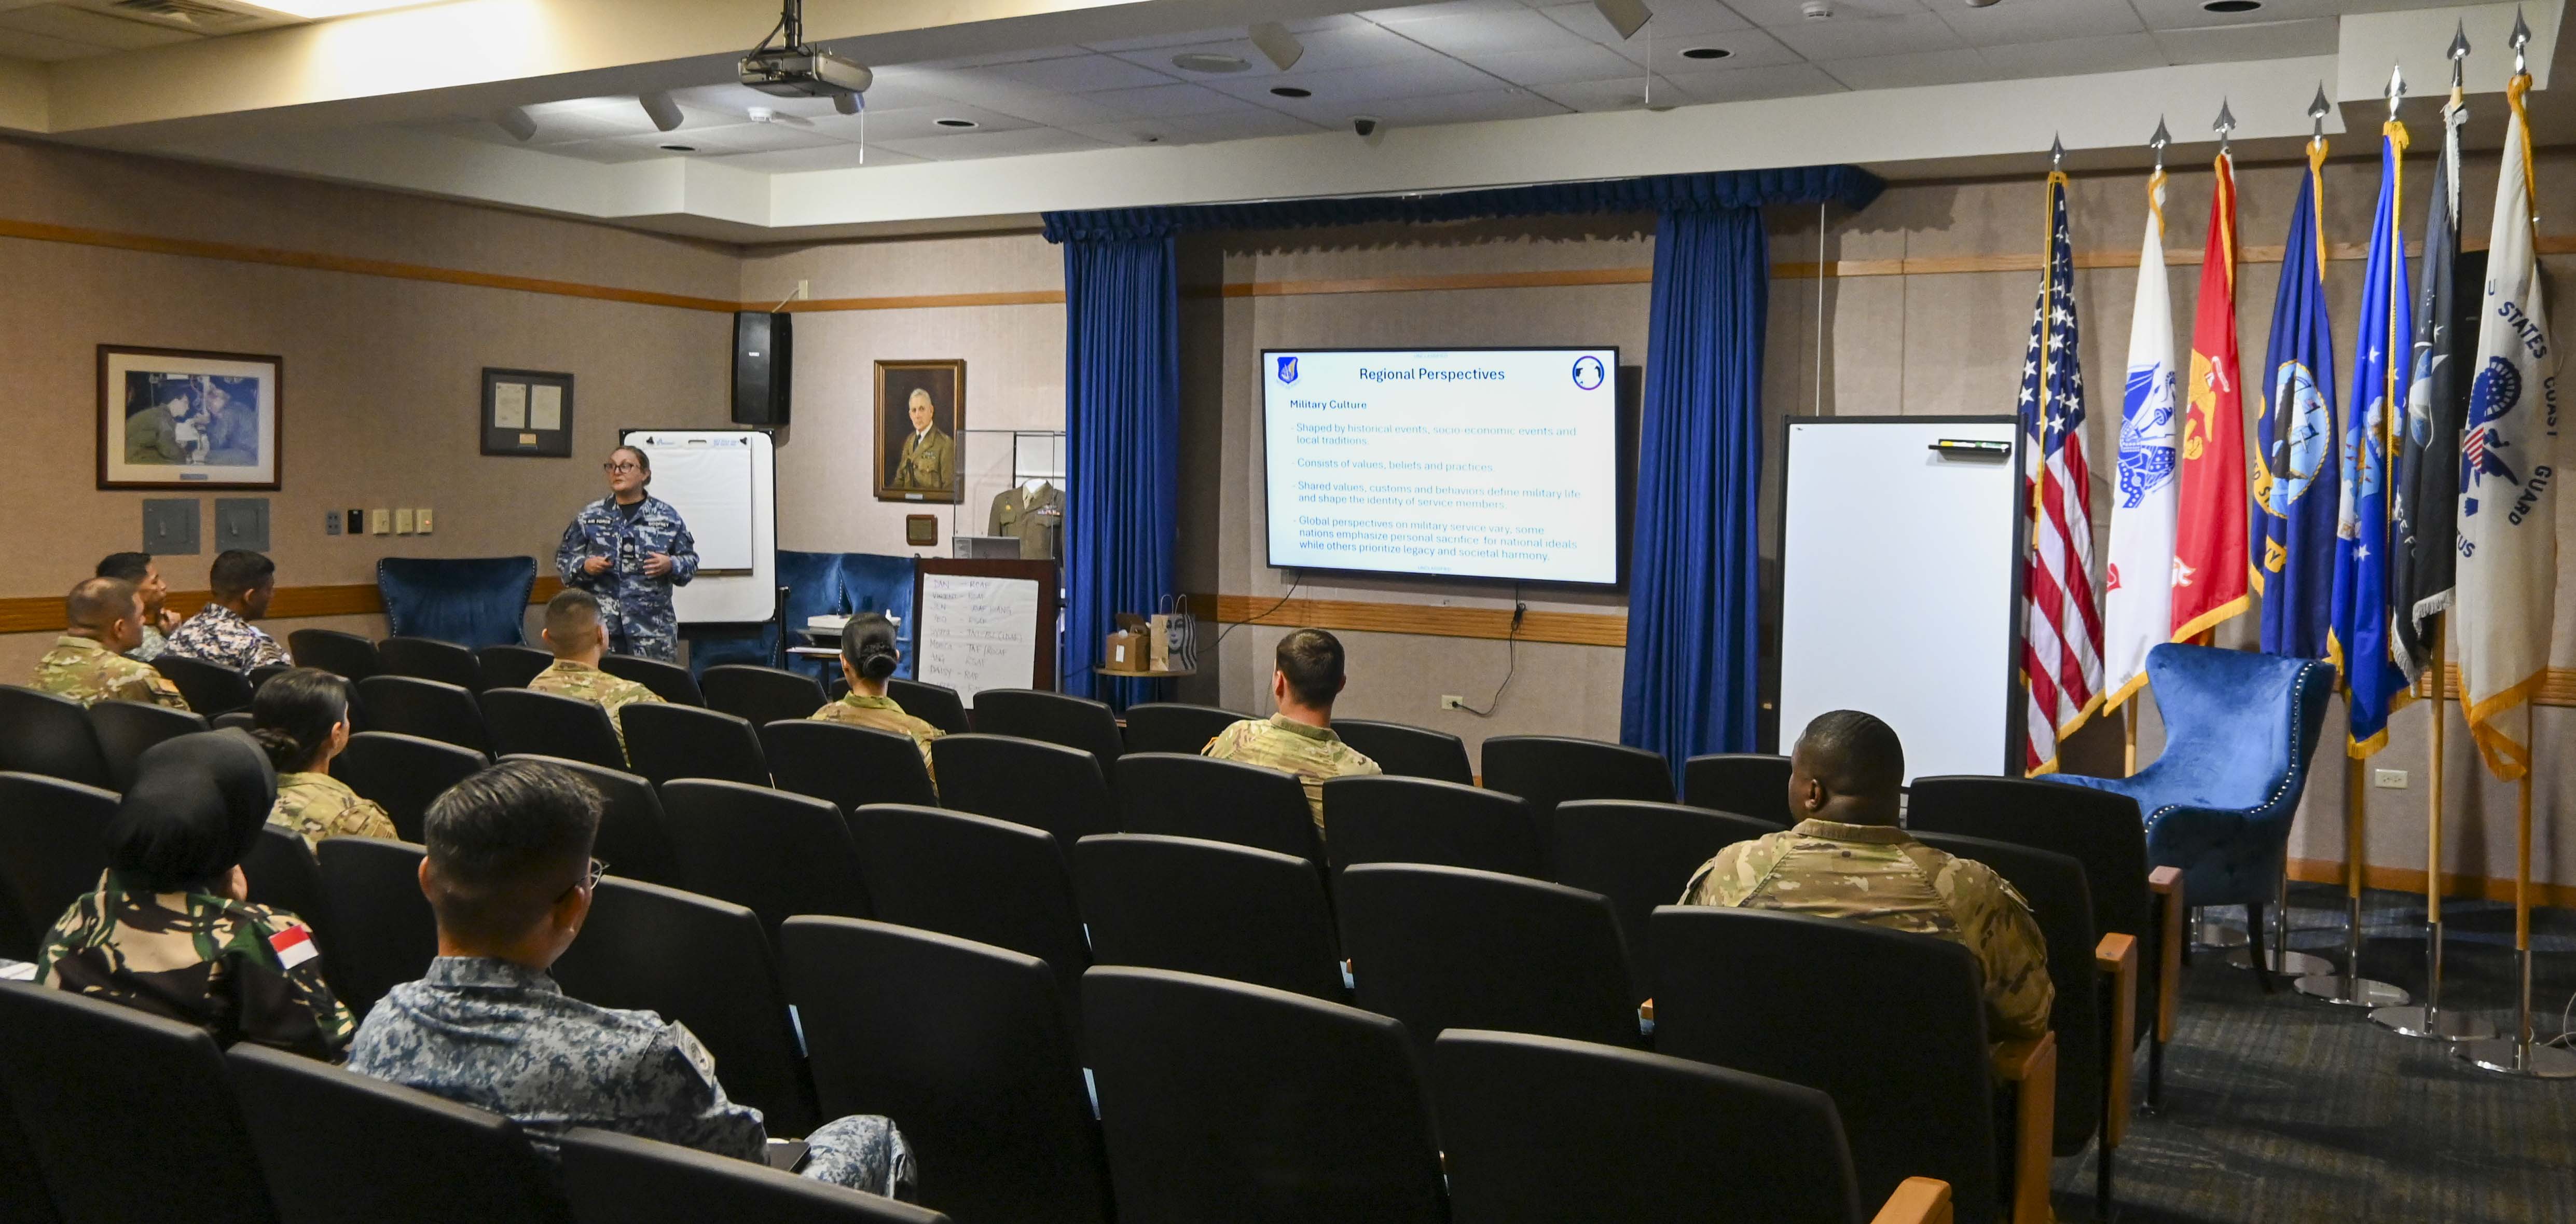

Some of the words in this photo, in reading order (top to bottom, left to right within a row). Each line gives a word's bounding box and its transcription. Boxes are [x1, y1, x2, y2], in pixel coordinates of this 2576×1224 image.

[2498, 301, 2547, 360] STATES
[1360, 368, 1414, 382] Regional
[1420, 368, 1504, 382] Perspectives
[1291, 400, 1326, 410] Military
[1330, 400, 1366, 409] Culture
[1297, 423, 1331, 433] Shaped
[1335, 423, 1345, 434] by
[1395, 426, 1430, 434] events,
[1556, 428, 1576, 436] and
[1297, 436, 1319, 444] local
[1298, 458, 1338, 467] Consists
[1353, 460, 1386, 469] values,
[1389, 461, 1421, 470] beliefs
[1299, 482, 1330, 490] Shared
[1333, 483, 1367, 492] values,
[1436, 486, 1484, 495] behaviors
[1487, 487, 1519, 496] define
[1523, 488, 1562, 499] military
[1565, 490, 1580, 498] life
[2508, 465, 2553, 526] GUARD
[1299, 494, 1315, 502] and
[1319, 494, 1346, 504] shape
[1368, 496, 1402, 506] identity
[1300, 516, 1329, 525] Global
[1333, 519, 1393, 528] perspectives
[1411, 521, 1448, 532] military
[1489, 526, 1512, 534] vary,
[1300, 529, 1333, 538] nations
[1337, 531, 1387, 541] emphasize
[1391, 534, 1432, 543] personal
[1437, 535, 1478, 544] sacrifice
[1501, 539, 1542, 547] national
[1546, 540, 1577, 548] ideals
[1300, 540, 1324, 549] while
[1327, 542, 1356, 551] others
[1359, 545, 1400, 553] prioritize
[1404, 545, 1435, 556] legacy
[1459, 549, 1498, 558] societal
[1502, 550, 1549, 562] harmony.
